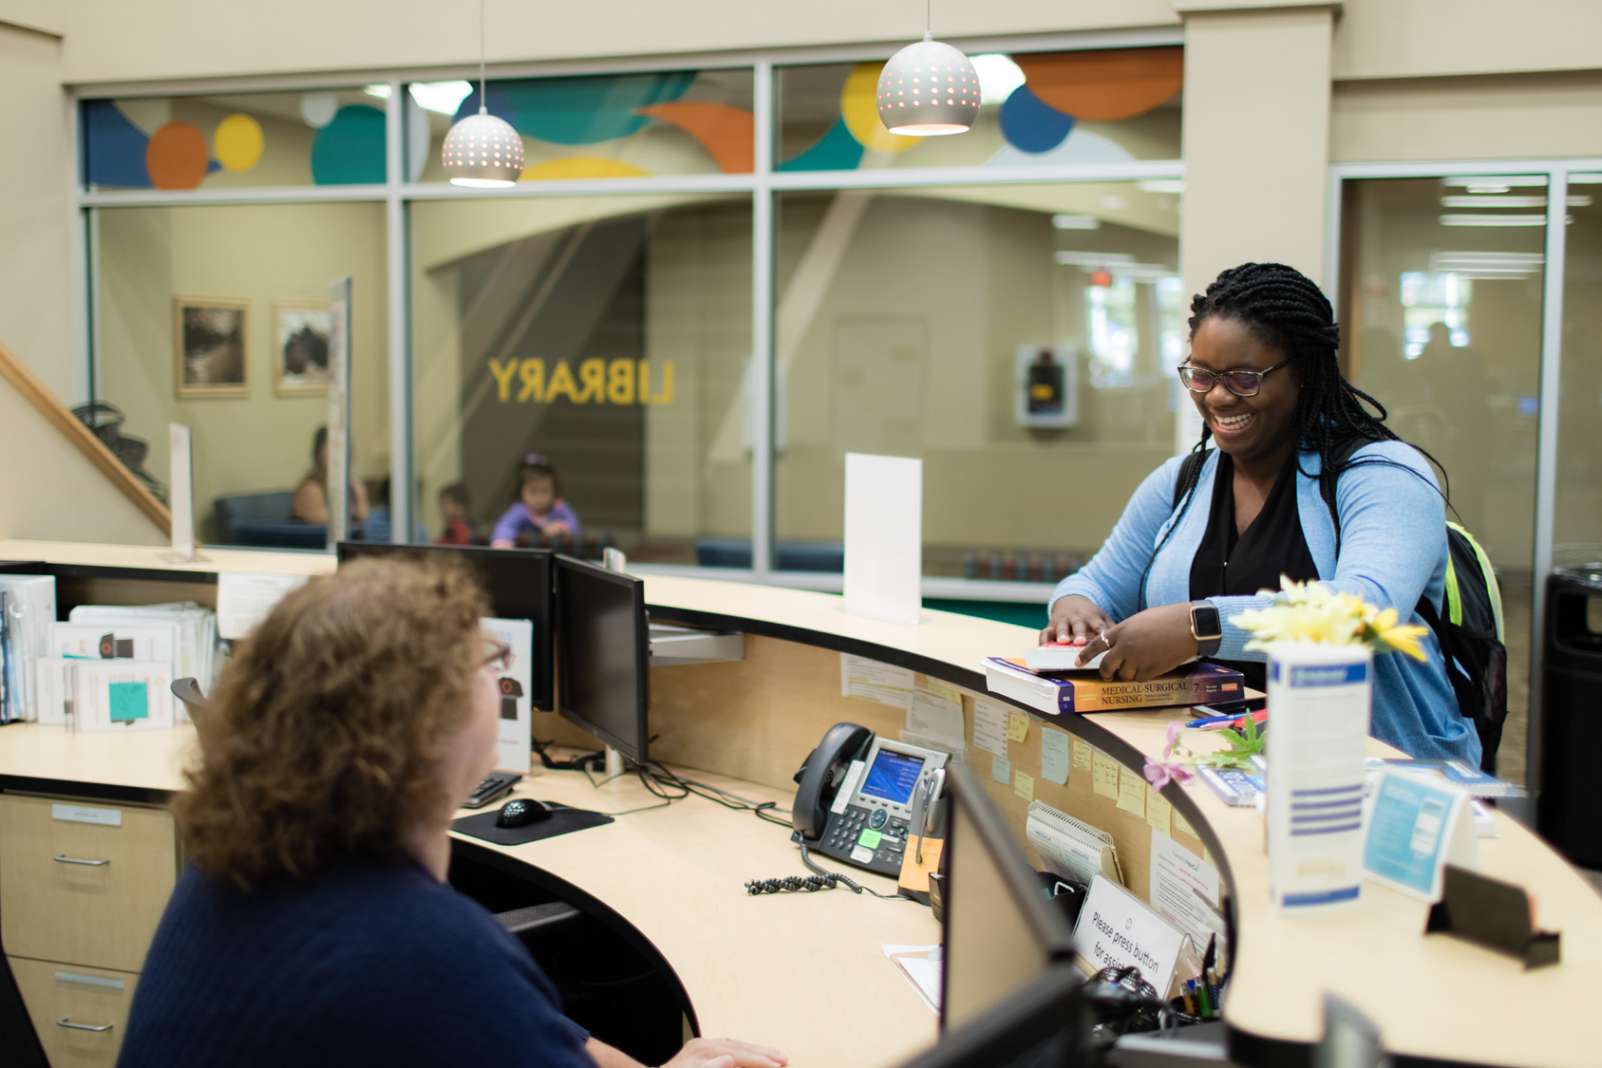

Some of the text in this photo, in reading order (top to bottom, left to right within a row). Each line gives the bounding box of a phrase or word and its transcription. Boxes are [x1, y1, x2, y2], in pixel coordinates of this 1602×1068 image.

[1101, 682, 1188, 695] MEDICAL-SURGICAL
[1101, 695, 1143, 705] NURSING
[1092, 911, 1159, 973] Please press button
[1094, 941, 1104, 959] for
